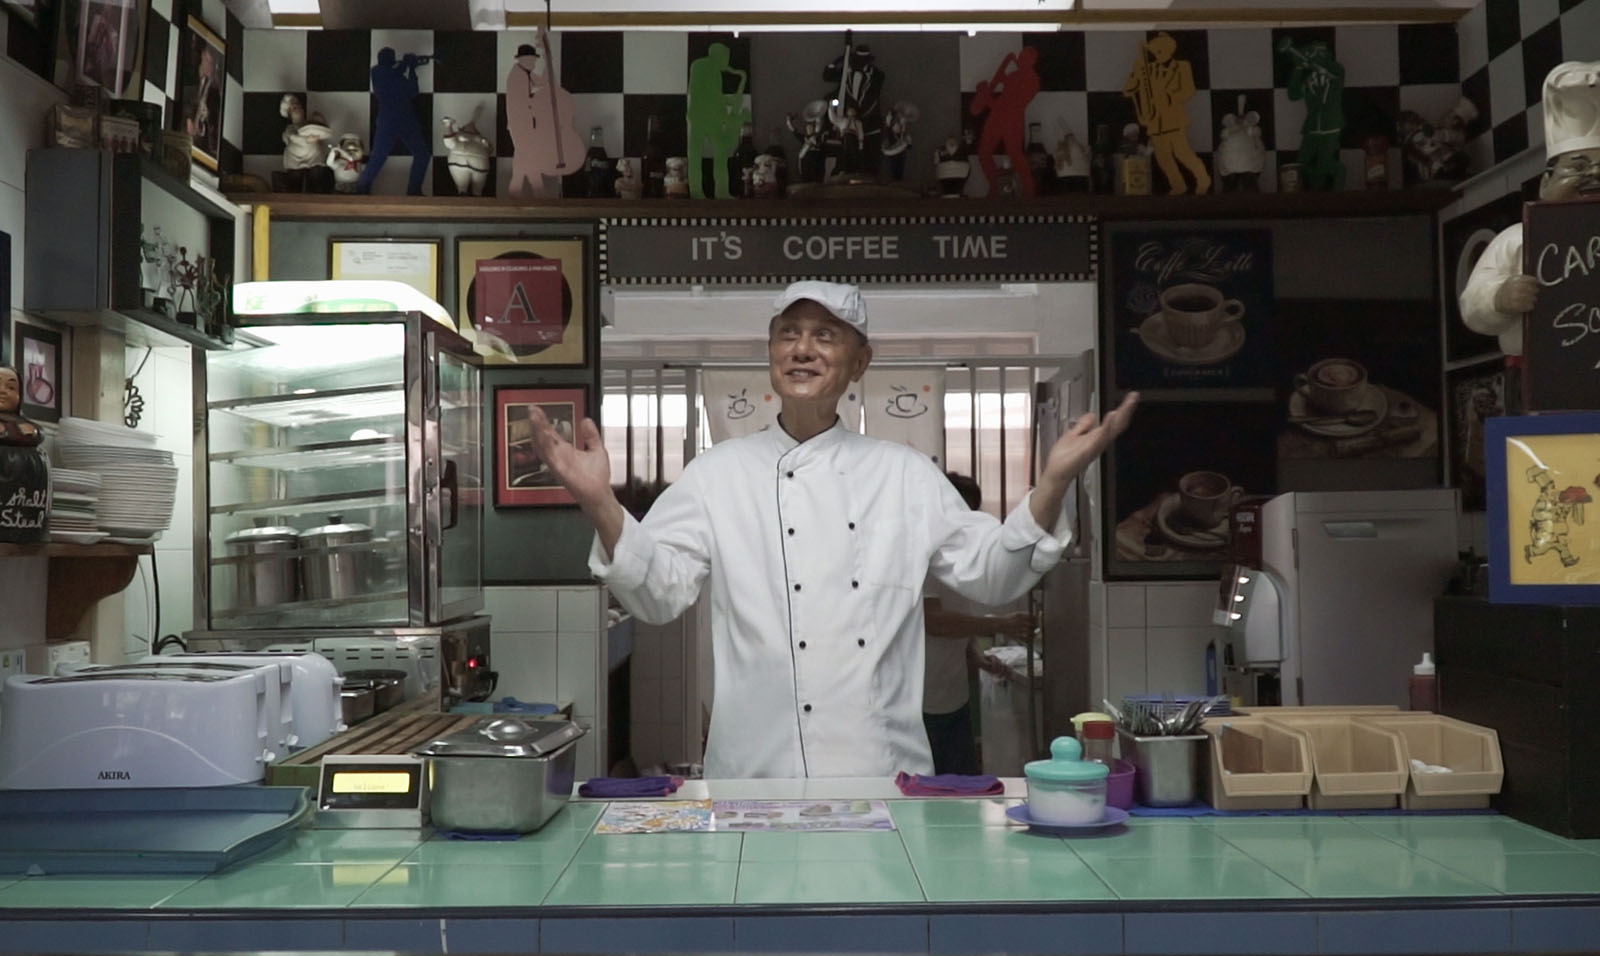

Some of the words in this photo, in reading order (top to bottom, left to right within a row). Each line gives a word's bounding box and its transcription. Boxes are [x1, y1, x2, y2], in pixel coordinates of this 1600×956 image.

[691, 231, 742, 260] IT'S
[782, 235, 899, 260] COFFEE
[932, 235, 1008, 259] TIME
[497, 281, 541, 323] A
[97, 771, 131, 780] AKIRA
